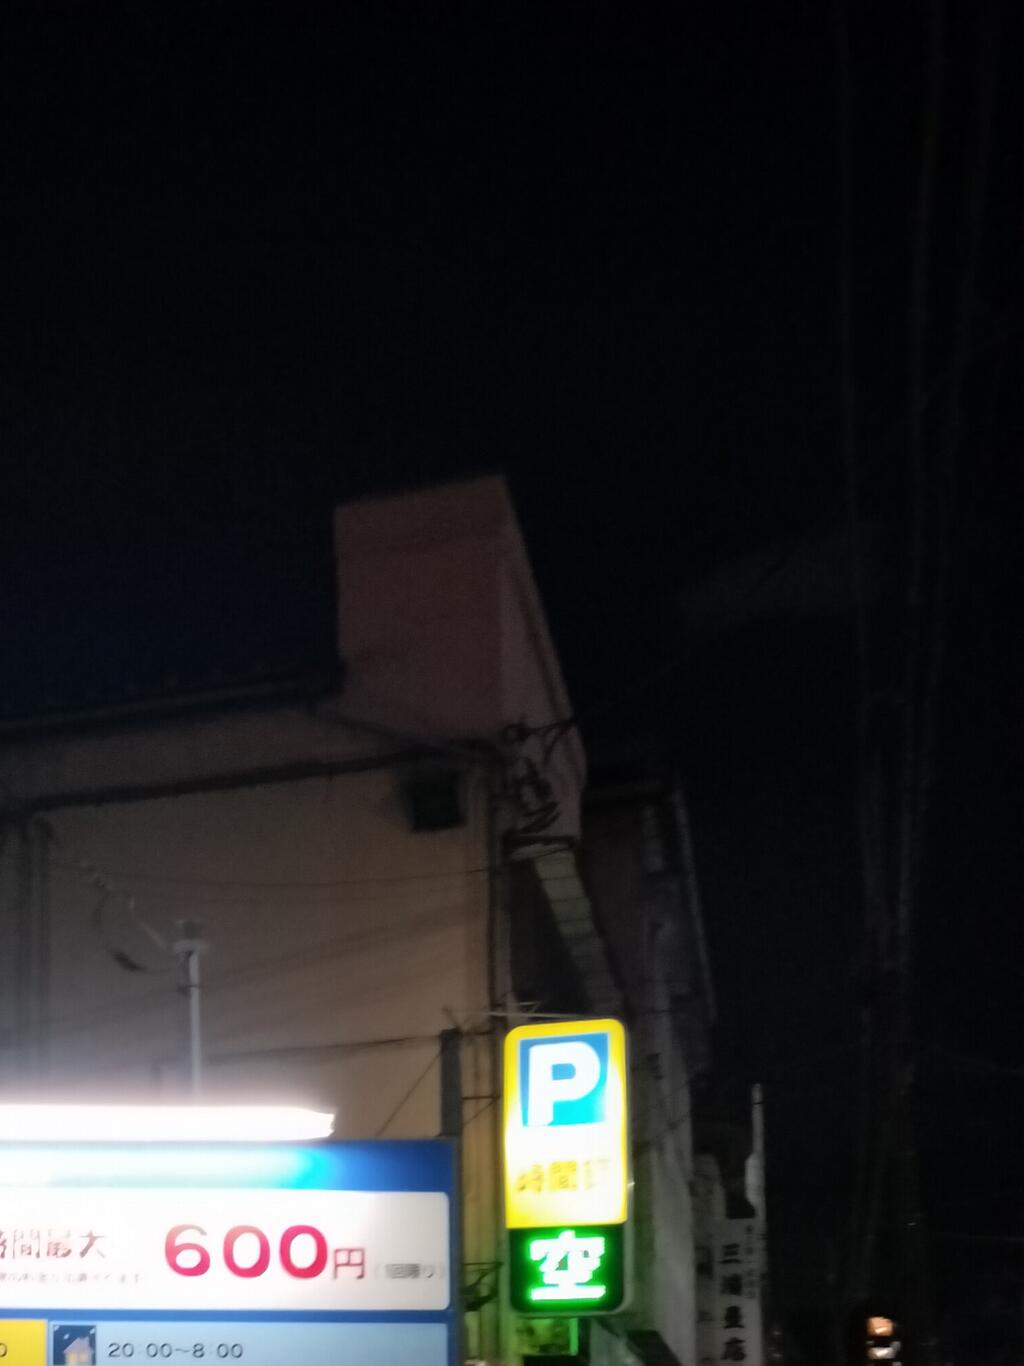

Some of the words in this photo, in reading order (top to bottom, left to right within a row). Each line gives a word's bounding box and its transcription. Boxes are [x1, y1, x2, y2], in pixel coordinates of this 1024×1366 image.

[527, 1040, 601, 1127] P
[164, 1223, 366, 1280] 600円
[530, 1230, 607, 1301] 空
